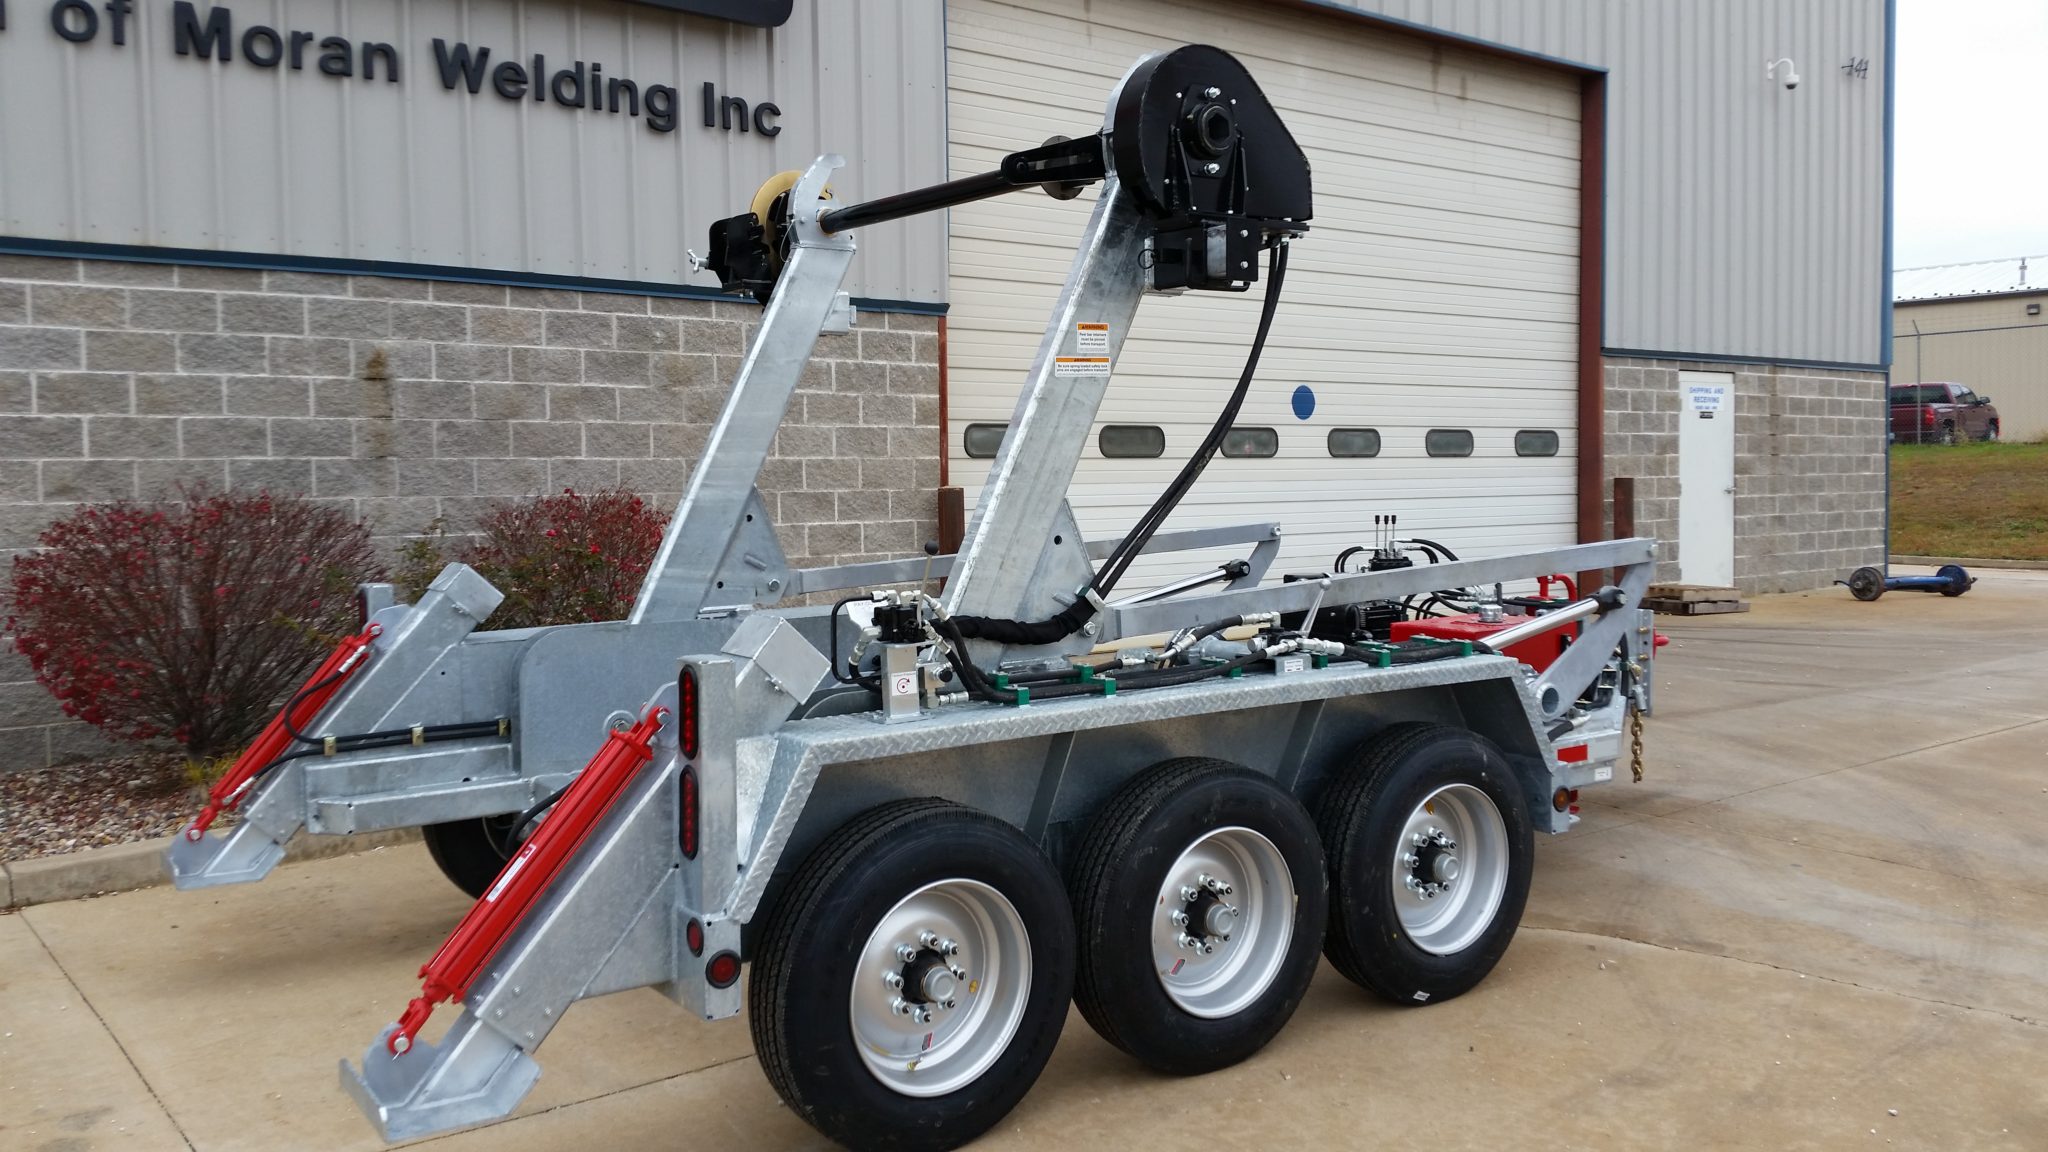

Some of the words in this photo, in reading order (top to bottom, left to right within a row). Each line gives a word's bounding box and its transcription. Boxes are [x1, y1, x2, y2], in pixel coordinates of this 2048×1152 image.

[51, 0, 132, 46] of
[173, 1, 399, 83] Moran
[432, 37, 677, 133] Welding
[703, 81, 782, 138] Inc
